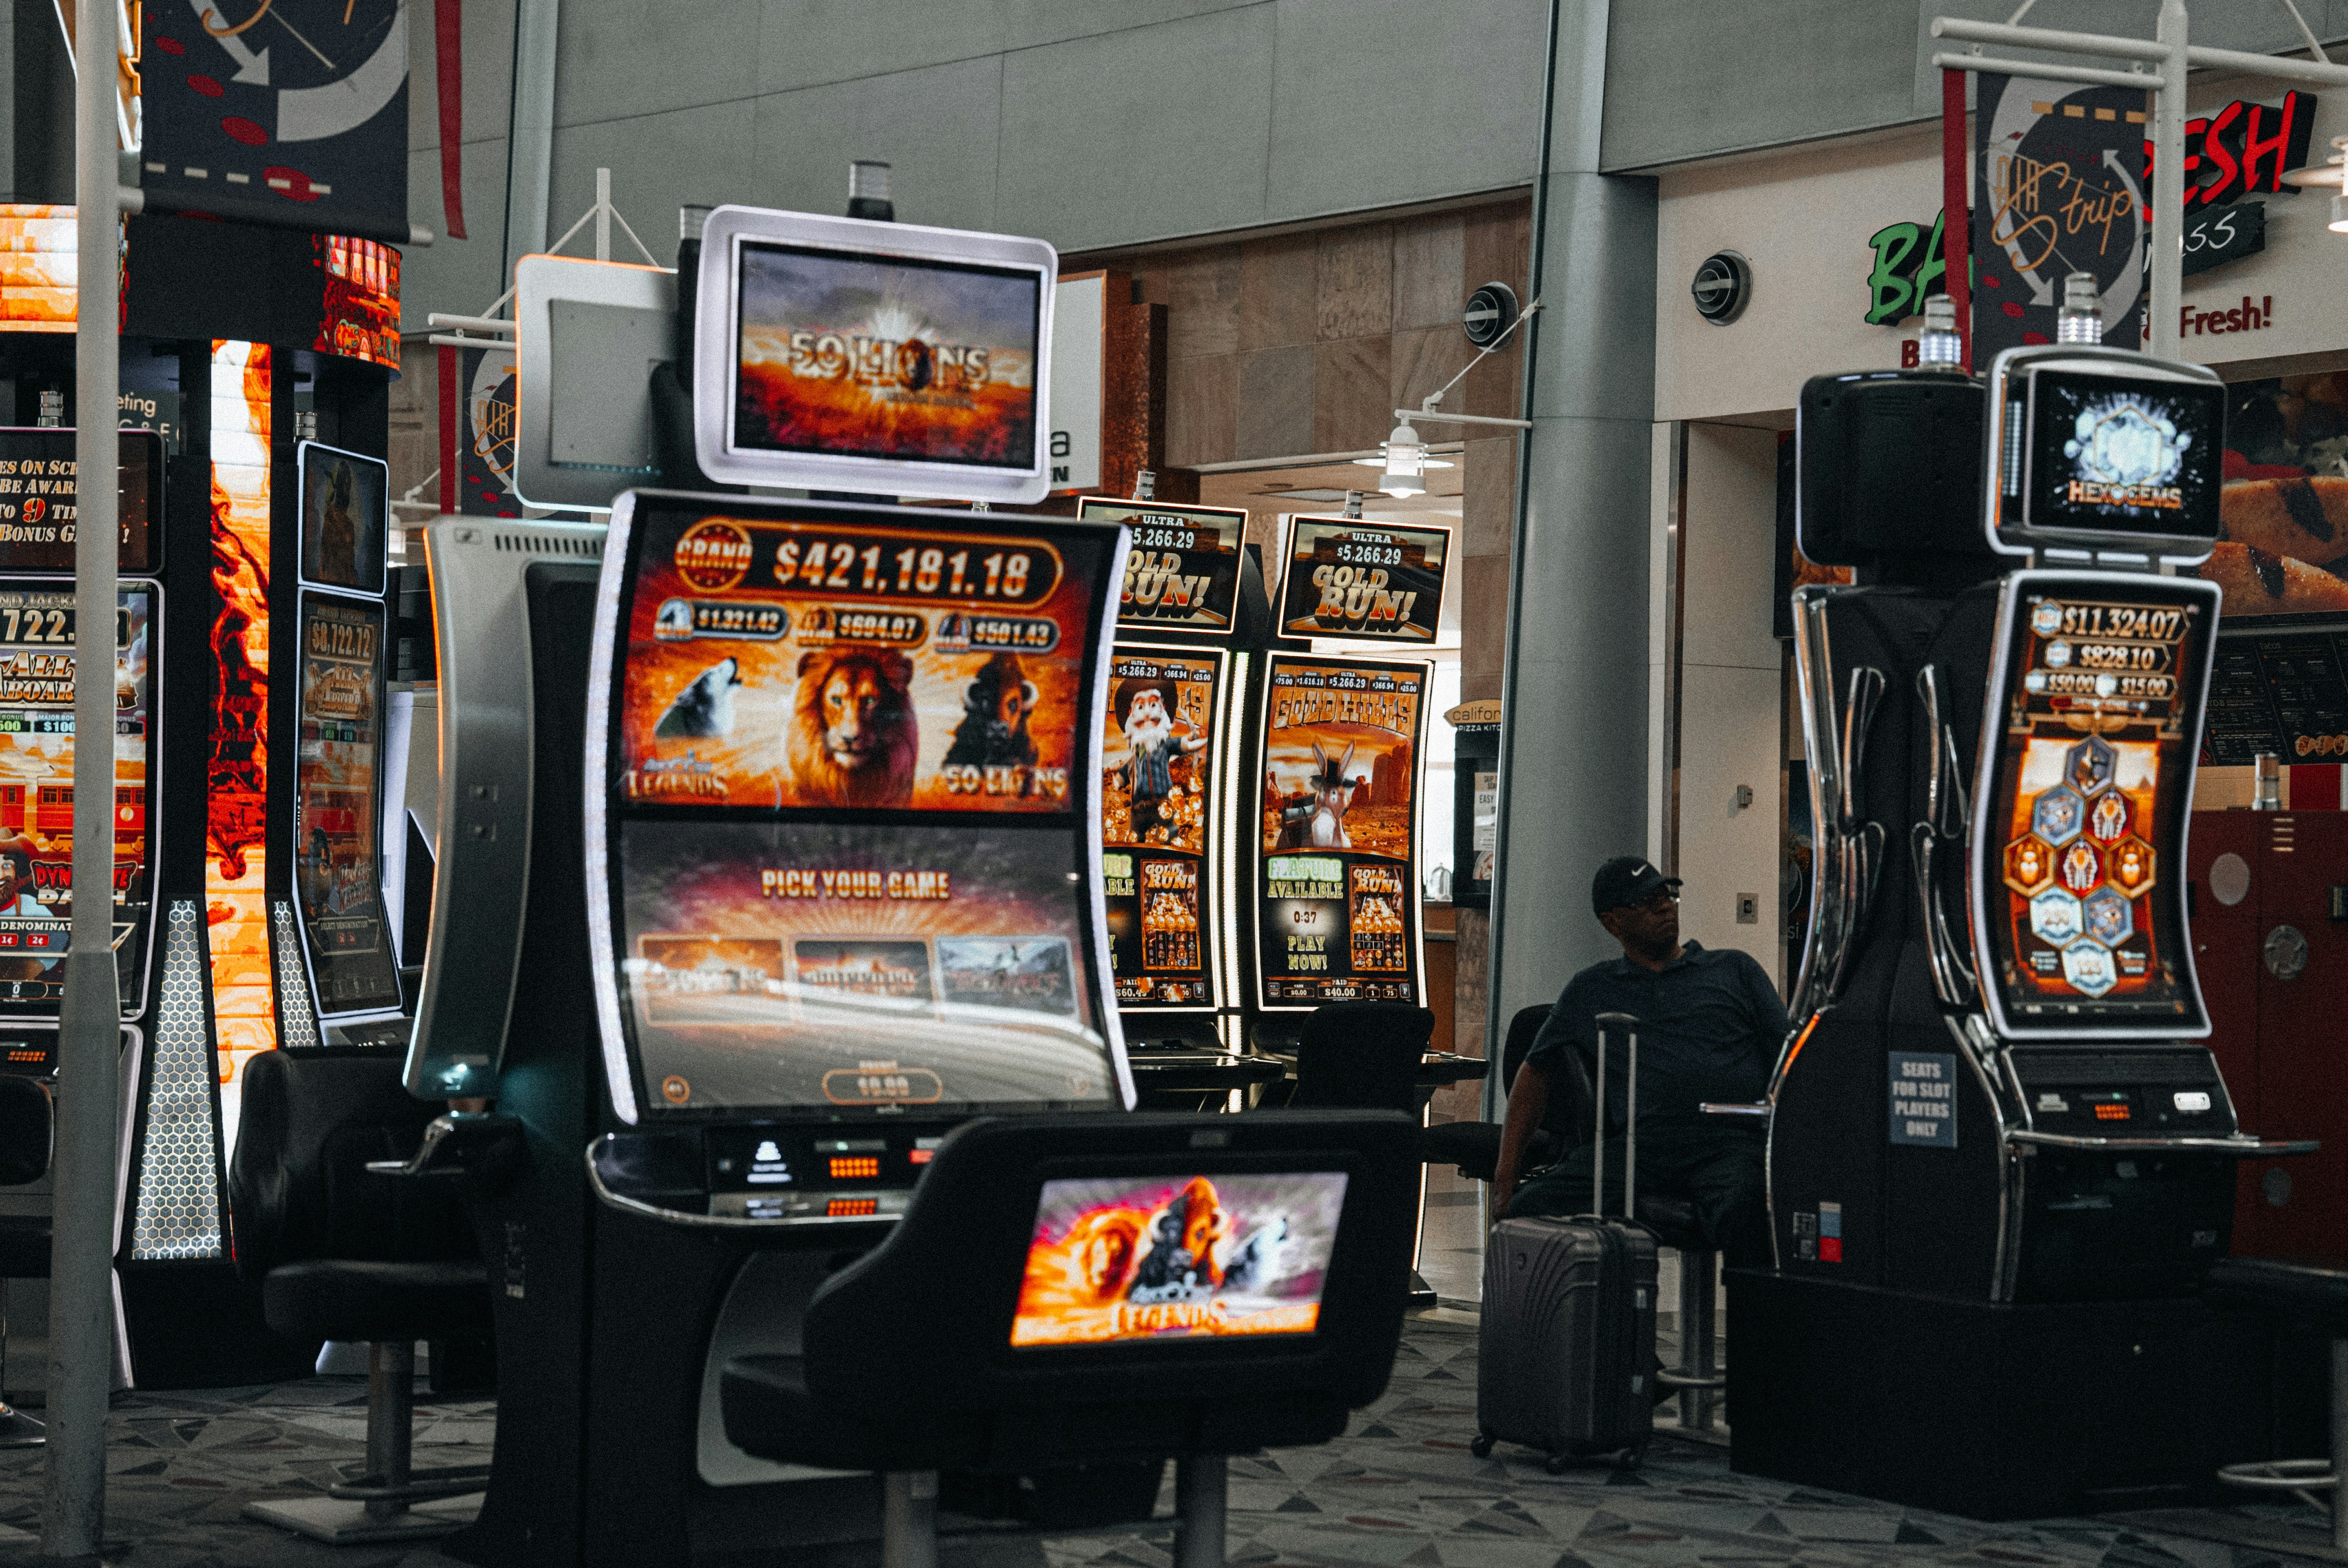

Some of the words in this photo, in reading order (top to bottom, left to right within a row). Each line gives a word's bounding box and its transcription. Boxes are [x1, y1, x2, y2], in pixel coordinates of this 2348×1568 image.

[1994, 155, 2039, 213] AIR
[1992, 161, 2132, 272] Strip
[475, 399, 509, 436] AIR
[20, 460, 45, 475] ON
[25, 479, 78, 494] AWAR
[2068, 479, 2182, 509] HEXOGEMS
[22, 497, 46, 523] 9
[1142, 514, 1185, 527] ULTRA
[0, 524, 55, 542] BONUS
[1131, 528, 1194, 549] 5,266.29
[1352, 532, 1392, 544] ULTRA
[676, 538, 752, 570] GRAND
[1127, 550, 1181, 574] OLD
[1337, 544, 1402, 565] $5,266.29
[773, 538, 1031, 597] $421,181.18
[1312, 564, 1389, 590] GOLD
[1314, 586, 1417, 622] RUN!
[3, 652, 73, 678] ALL
[1119, 666, 1157, 678] $5,266.29
[1329, 677, 1366, 689] $5,266.29
[1479, 794, 1494, 804] EASY
[761, 869, 818, 898] PICK
[821, 870, 882, 898] YOUR
[887, 871, 949, 899] GAME
[1267, 881, 1343, 899] AVAILABLE
[1294, 911, 1317, 924] 0:37
[1288, 935, 1326, 952] PLAY
[1288, 954, 1327, 970] NOW!
[1324, 987, 1356, 997] $40.00
[1902, 1061, 1942, 1079] SEATS
[1892, 1081, 1918, 1097] FOR
[1919, 1082, 1951, 1098] SLOT
[1894, 1100, 1950, 1118] PLAYERS
[1906, 1120, 1938, 1137] ONLY
[1111, 1298, 1229, 1334] LEGENDS
